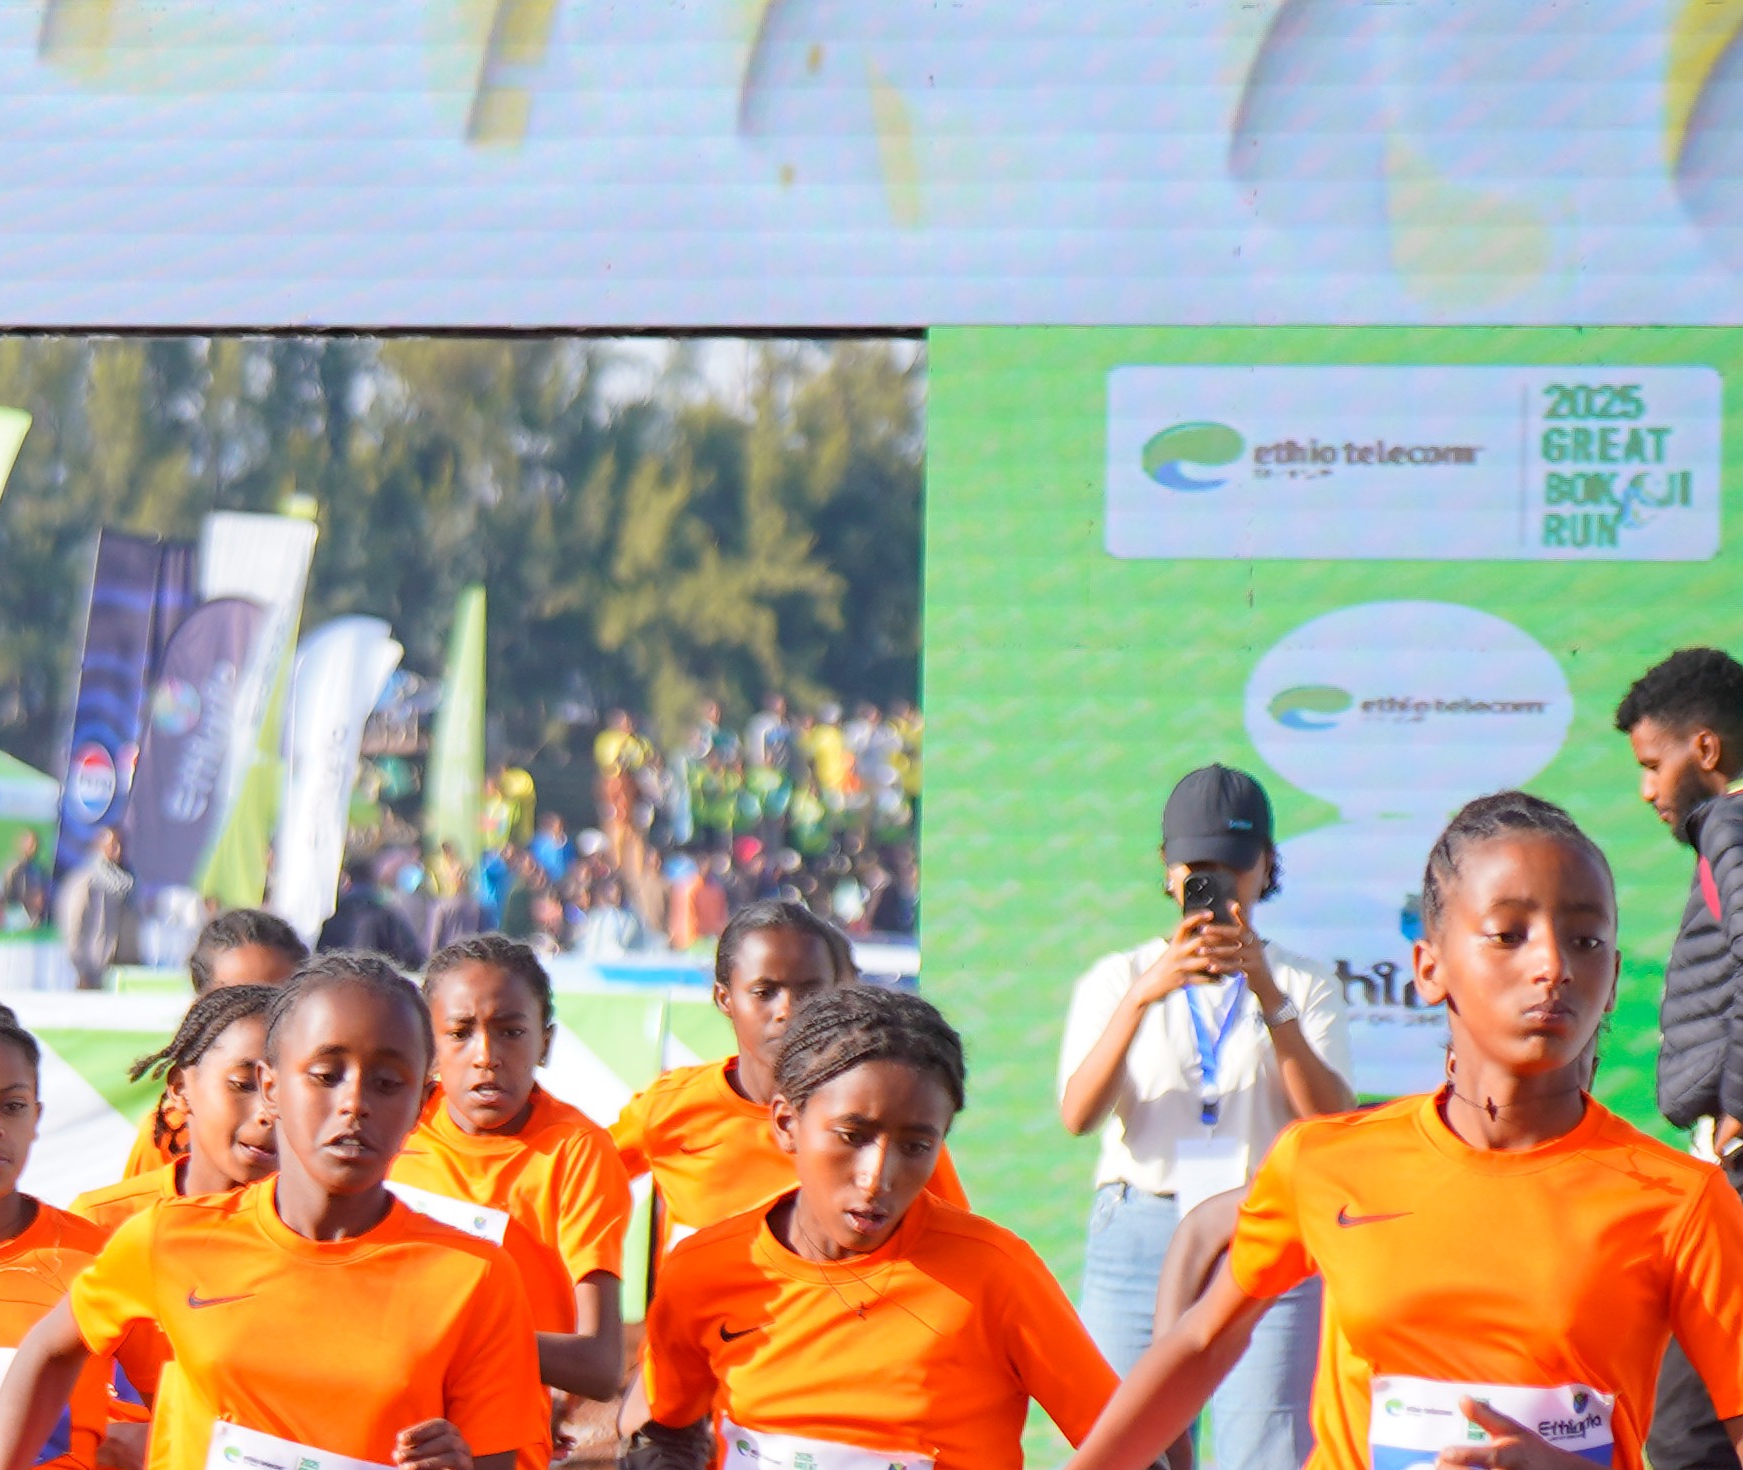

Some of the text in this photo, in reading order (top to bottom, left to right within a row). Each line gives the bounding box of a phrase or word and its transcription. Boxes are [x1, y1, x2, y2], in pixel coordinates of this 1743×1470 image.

[1542, 384, 1647, 419] 2025
[1542, 427, 1673, 464] GREAT
[1542, 514, 1620, 547] RUN
